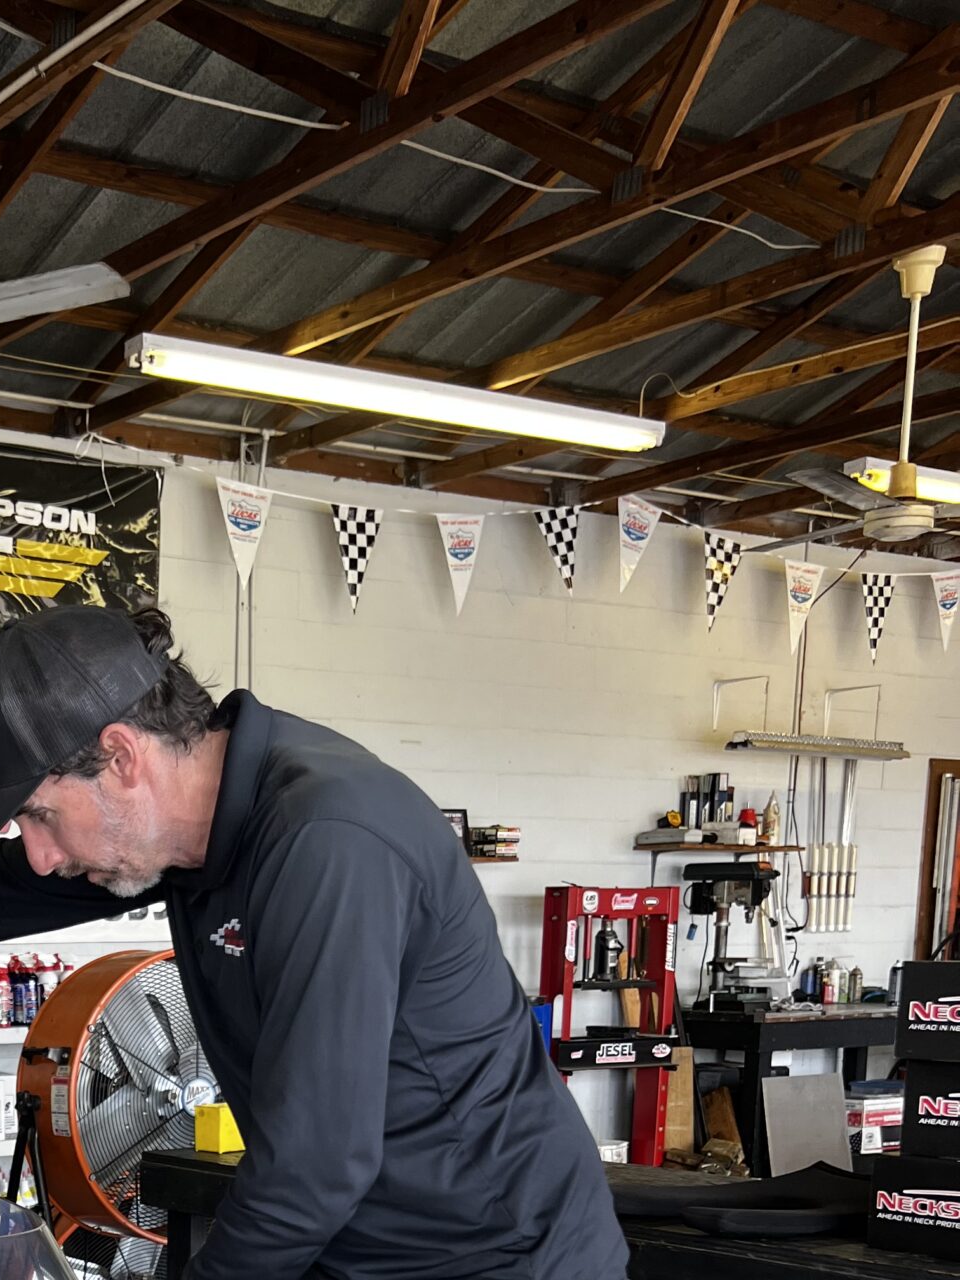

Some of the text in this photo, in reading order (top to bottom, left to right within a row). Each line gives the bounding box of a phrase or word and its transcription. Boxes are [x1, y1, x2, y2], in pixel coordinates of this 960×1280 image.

[597, 1043, 634, 1058] JESEL
[918, 1118, 948, 1126] AHEAD
[876, 1212, 903, 1222] AHEAD
[913, 1217, 935, 1226] NECK
